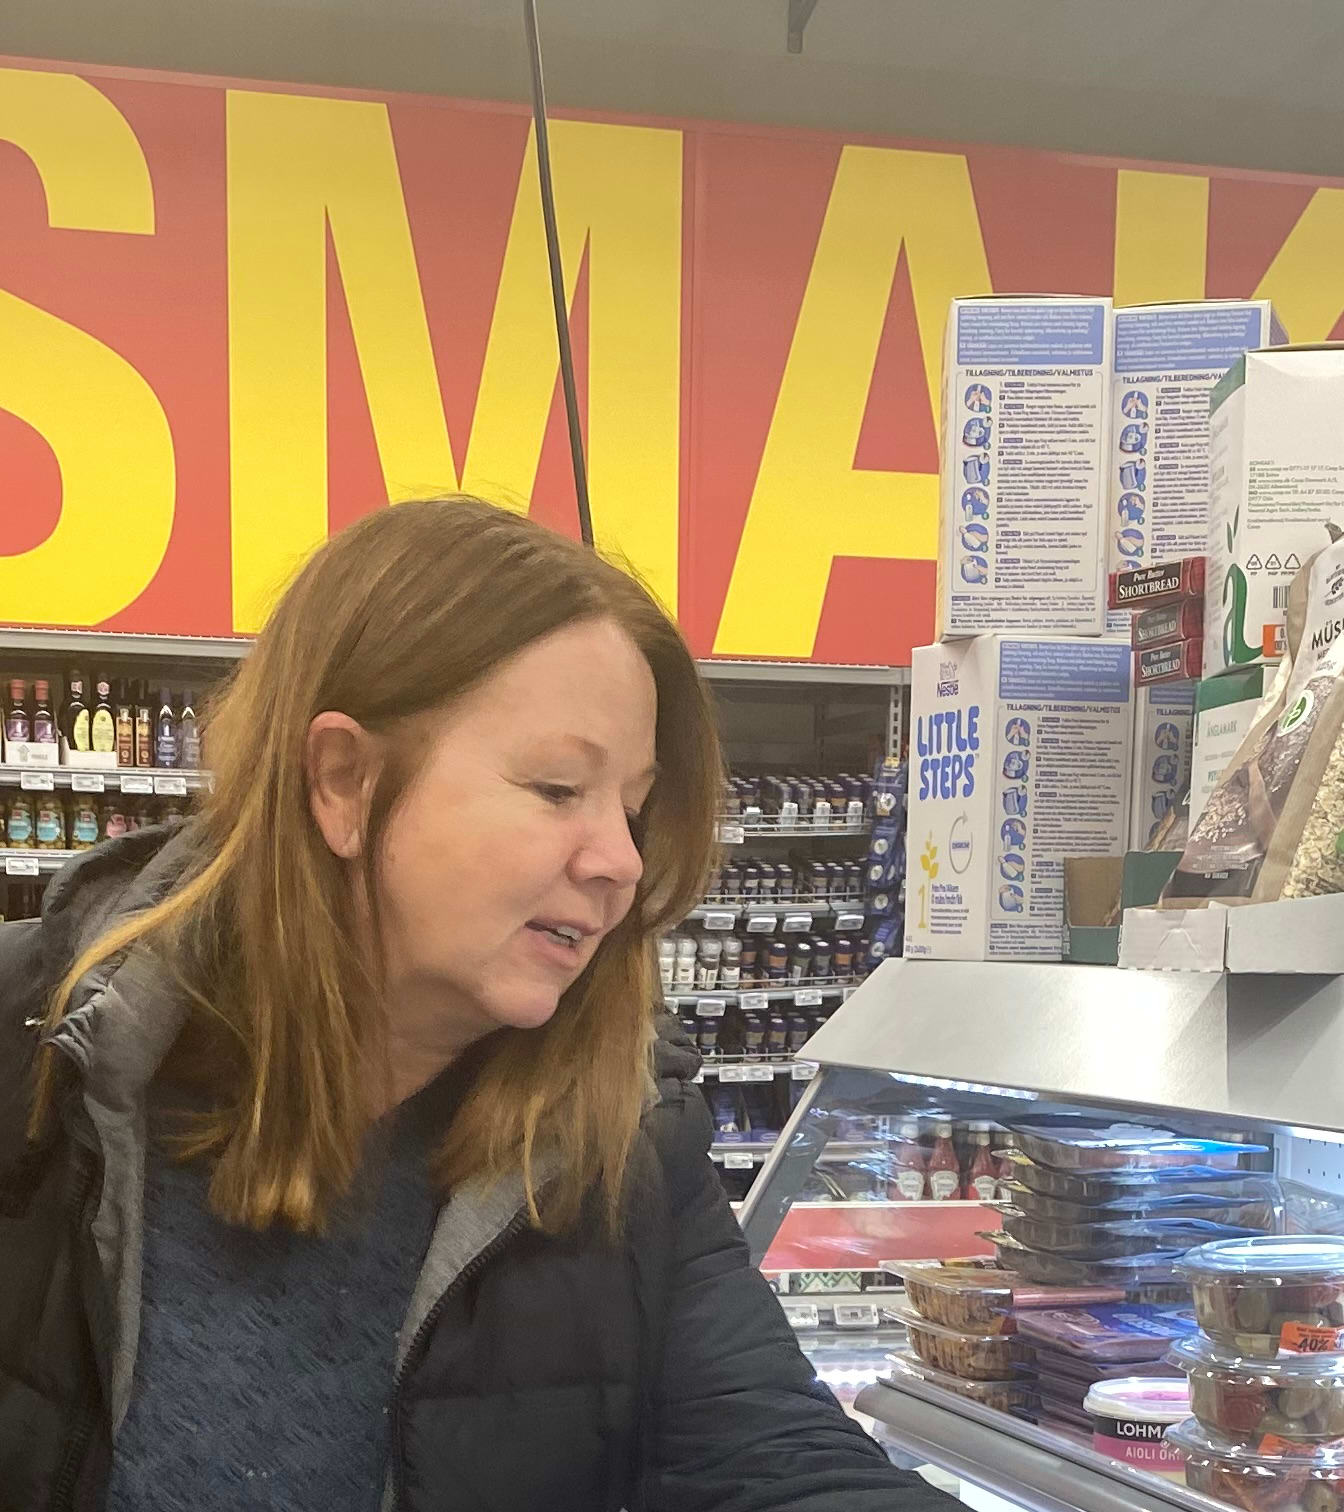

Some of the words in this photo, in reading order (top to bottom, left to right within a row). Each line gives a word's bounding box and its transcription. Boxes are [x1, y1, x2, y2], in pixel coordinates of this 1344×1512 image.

[1118, 577, 1180, 600] SHORTBREAD
[917, 705, 980, 758] LITTLE
[919, 753, 976, 801] STEPS
